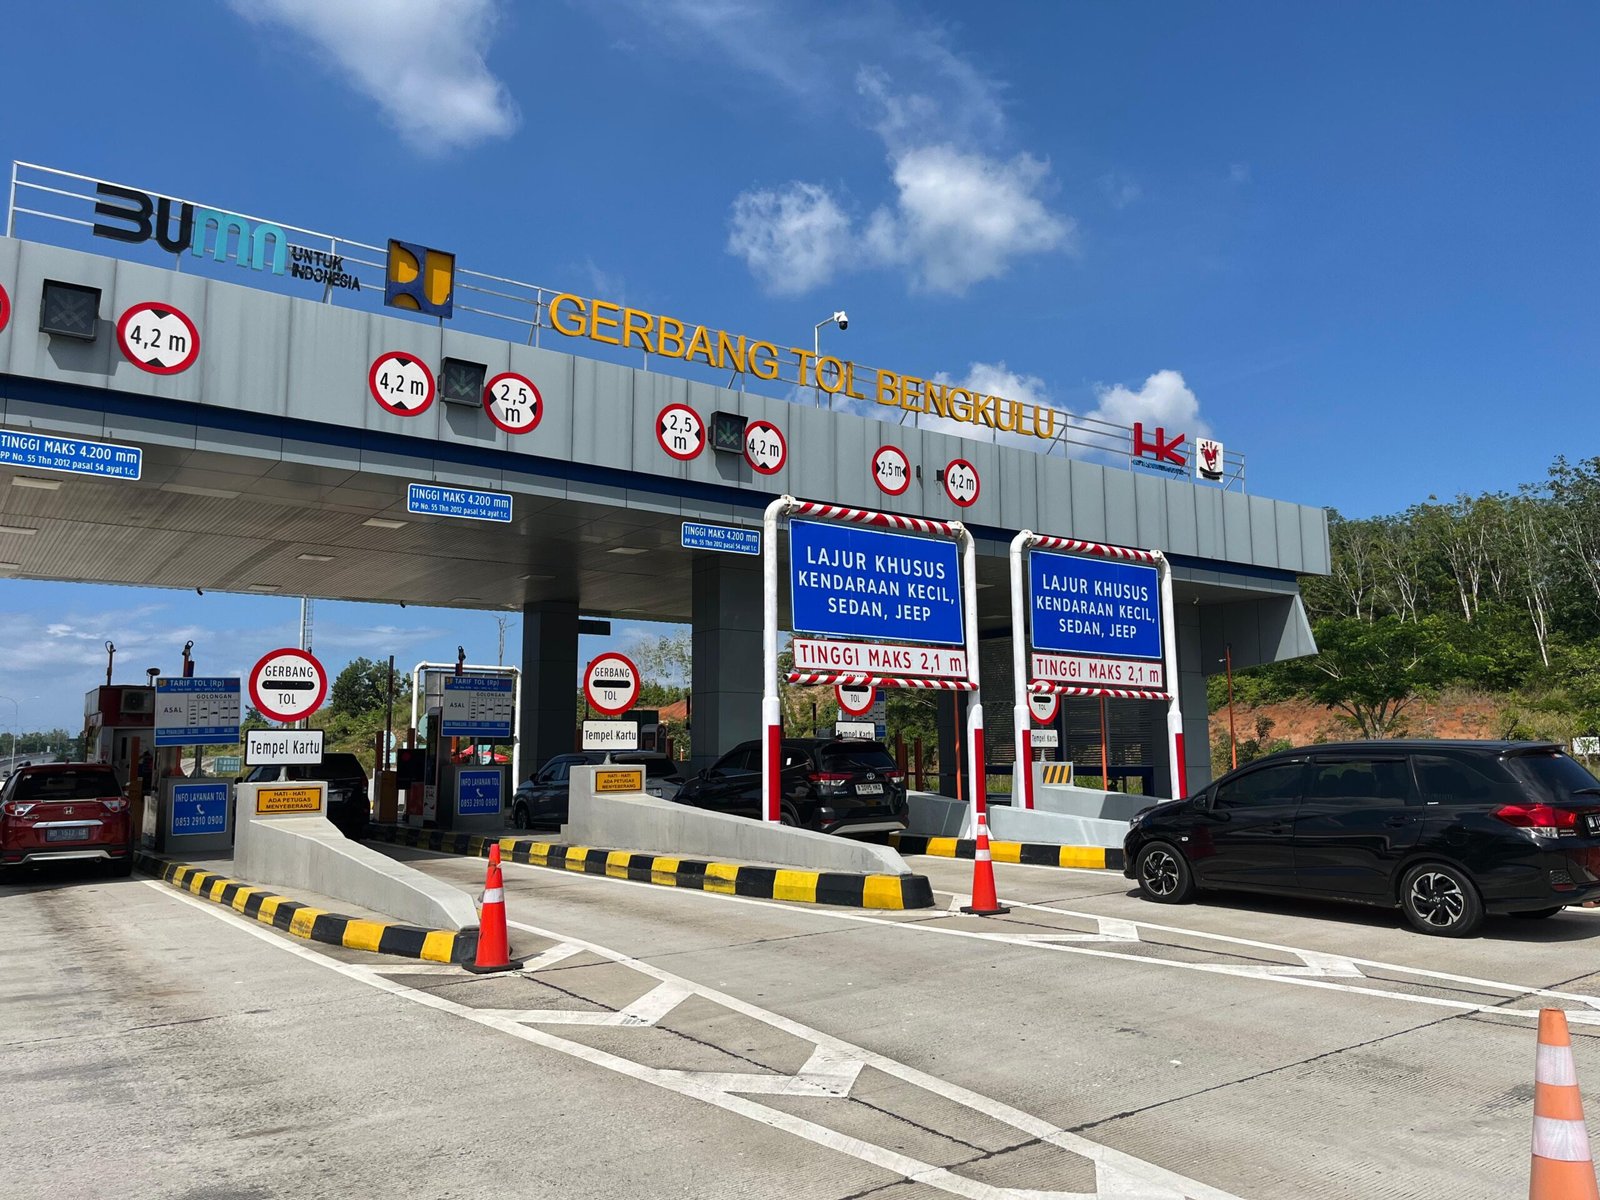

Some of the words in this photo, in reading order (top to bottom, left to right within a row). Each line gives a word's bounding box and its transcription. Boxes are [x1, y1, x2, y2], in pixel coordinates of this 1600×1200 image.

[291, 246, 344, 272] UNTUK
[291, 262, 361, 291] INDONESIA
[130, 325, 162, 350] 4,2
[168, 334, 186, 352] m
[549, 293, 778, 380] GERBANG
[790, 347, 865, 400] TOL
[876, 368, 1054, 439] BENGKULU
[380, 372, 404, 394] 4,2
[410, 380, 424, 396] m
[500, 384, 527, 406] 2,5
[505, 407, 520, 423] m
[670, 414, 692, 434] 2,5
[0, 434, 40, 450] TINGGI
[44, 440, 76, 456] MAKS
[80, 446, 112, 460] 4.200
[116, 451, 137, 464] mm
[674, 436, 687, 450] m
[748, 438, 766, 456] 4,2
[770, 444, 780, 458] m
[1133, 422, 1186, 466] HK
[0, 451, 10, 460] PP
[12, 452, 24, 462] No.
[27, 454, 36, 463] 55
[38, 456, 52, 465] Thn
[54, 458, 70, 468] 2012
[72, 460, 94, 470] pasal
[96, 463, 104, 472] 54
[106, 465, 122, 476] ayat
[880, 461, 893, 478] 2,5
[894, 465, 902, 478] m
[950, 473, 964, 490] 4,2
[966, 478, 974, 491] m
[412, 488, 440, 500] TINGGI
[442, 492, 466, 504] MAKS
[468, 494, 490, 506] 4.200
[494, 498, 508, 508] mm
[488, 510, 500, 518] ayat
[685, 526, 706, 536] TINGGI
[708, 528, 725, 539] MAKS
[726, 531, 744, 541] 4.200
[746, 534, 758, 543] mm
[807, 546, 866, 570] LAJUR
[875, 555, 945, 580] KHUSUS
[798, 570, 900, 596] KENDARAAN
[908, 582, 954, 605] KECIL,
[1043, 574, 1088, 594] LAJUR
[1094, 580, 1148, 602] KHUSUS
[828, 597, 888, 621] SEDAN,
[896, 604, 931, 622] JEEP
[1036, 596, 1113, 617] KENDARAAN
[1120, 604, 1156, 624] KECIL,
[1059, 618, 1104, 638] SEDAN,
[1110, 624, 1137, 638] JEEP
[800, 644, 860, 666] TINGGI
[869, 648, 912, 669] MAKS
[920, 652, 940, 674] 2,1
[950, 656, 962, 672] m
[265, 665, 314, 678] GERBANG
[594, 667, 630, 678] GERBANG
[1036, 658, 1081, 678] TINGGI
[1089, 662, 1121, 680] MAKS
[1128, 666, 1144, 684] 2,1
[1150, 669, 1159, 683] m
[278, 693, 296, 705] TOL
[604, 690, 617, 700] TOL
[850, 694, 860, 703] TOL
[585, 730, 613, 742] Tempel
[616, 730, 636, 740] Kartu
[1032, 735, 1046, 743] Tempel
[251, 739, 288, 758] Tempel
[293, 740, 320, 755] Kartu
[175, 793, 188, 802] INFO
[190, 792, 215, 802] LAYANAN
[216, 792, 225, 800] TOL
